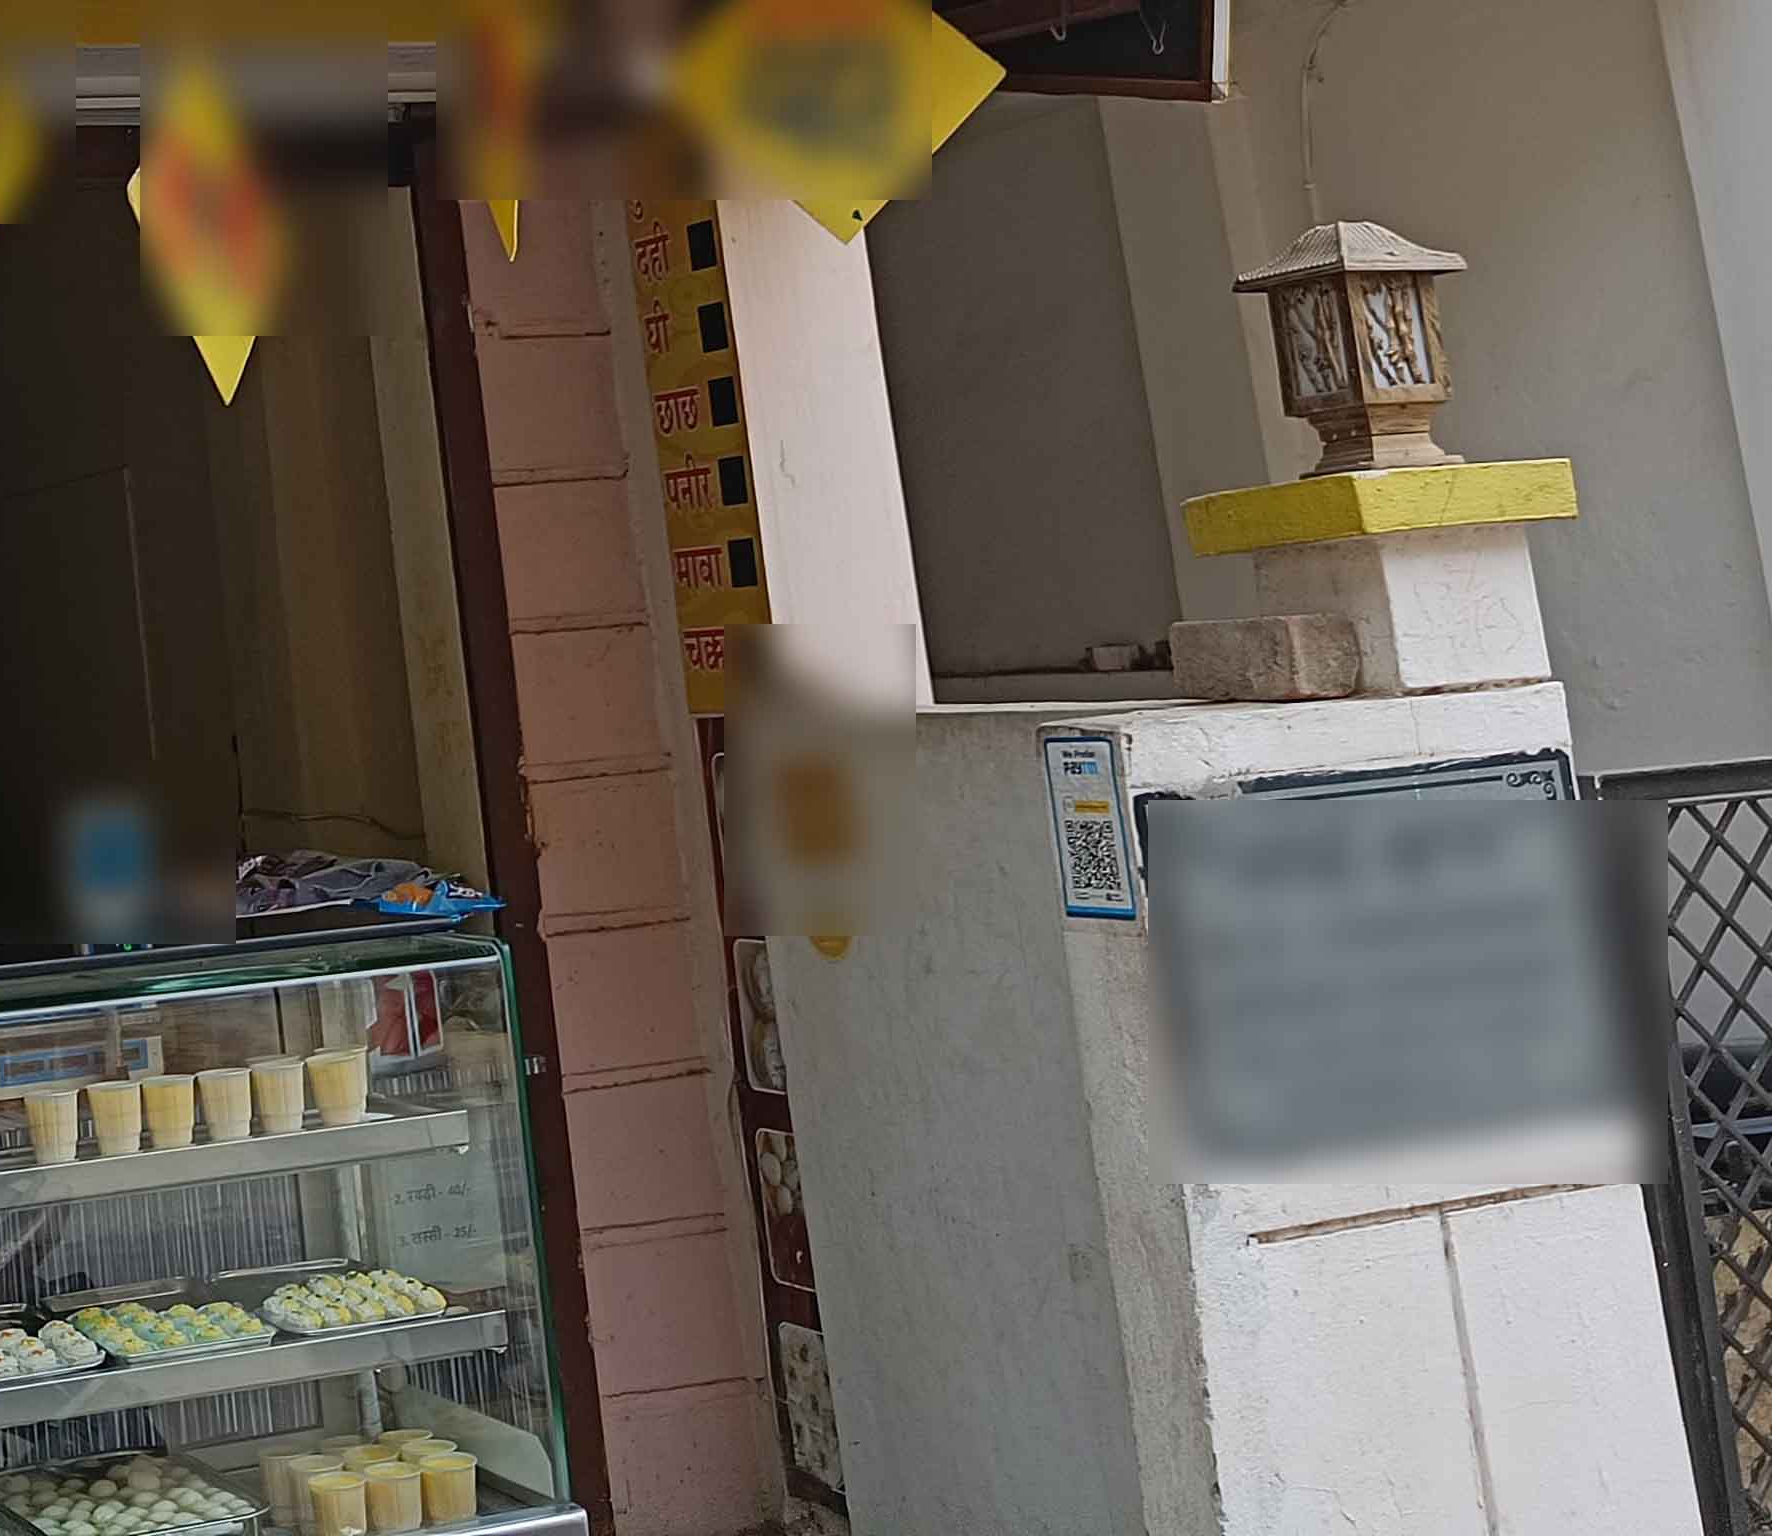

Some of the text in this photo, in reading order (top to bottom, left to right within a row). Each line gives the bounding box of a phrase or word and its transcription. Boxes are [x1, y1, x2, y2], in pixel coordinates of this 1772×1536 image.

[635, 221, 669, 281] दही
[644, 299, 669, 353] घी
[654, 387, 700, 434] छाछ
[665, 452, 712, 509] पनीर
[674, 546, 724, 588] मावा
